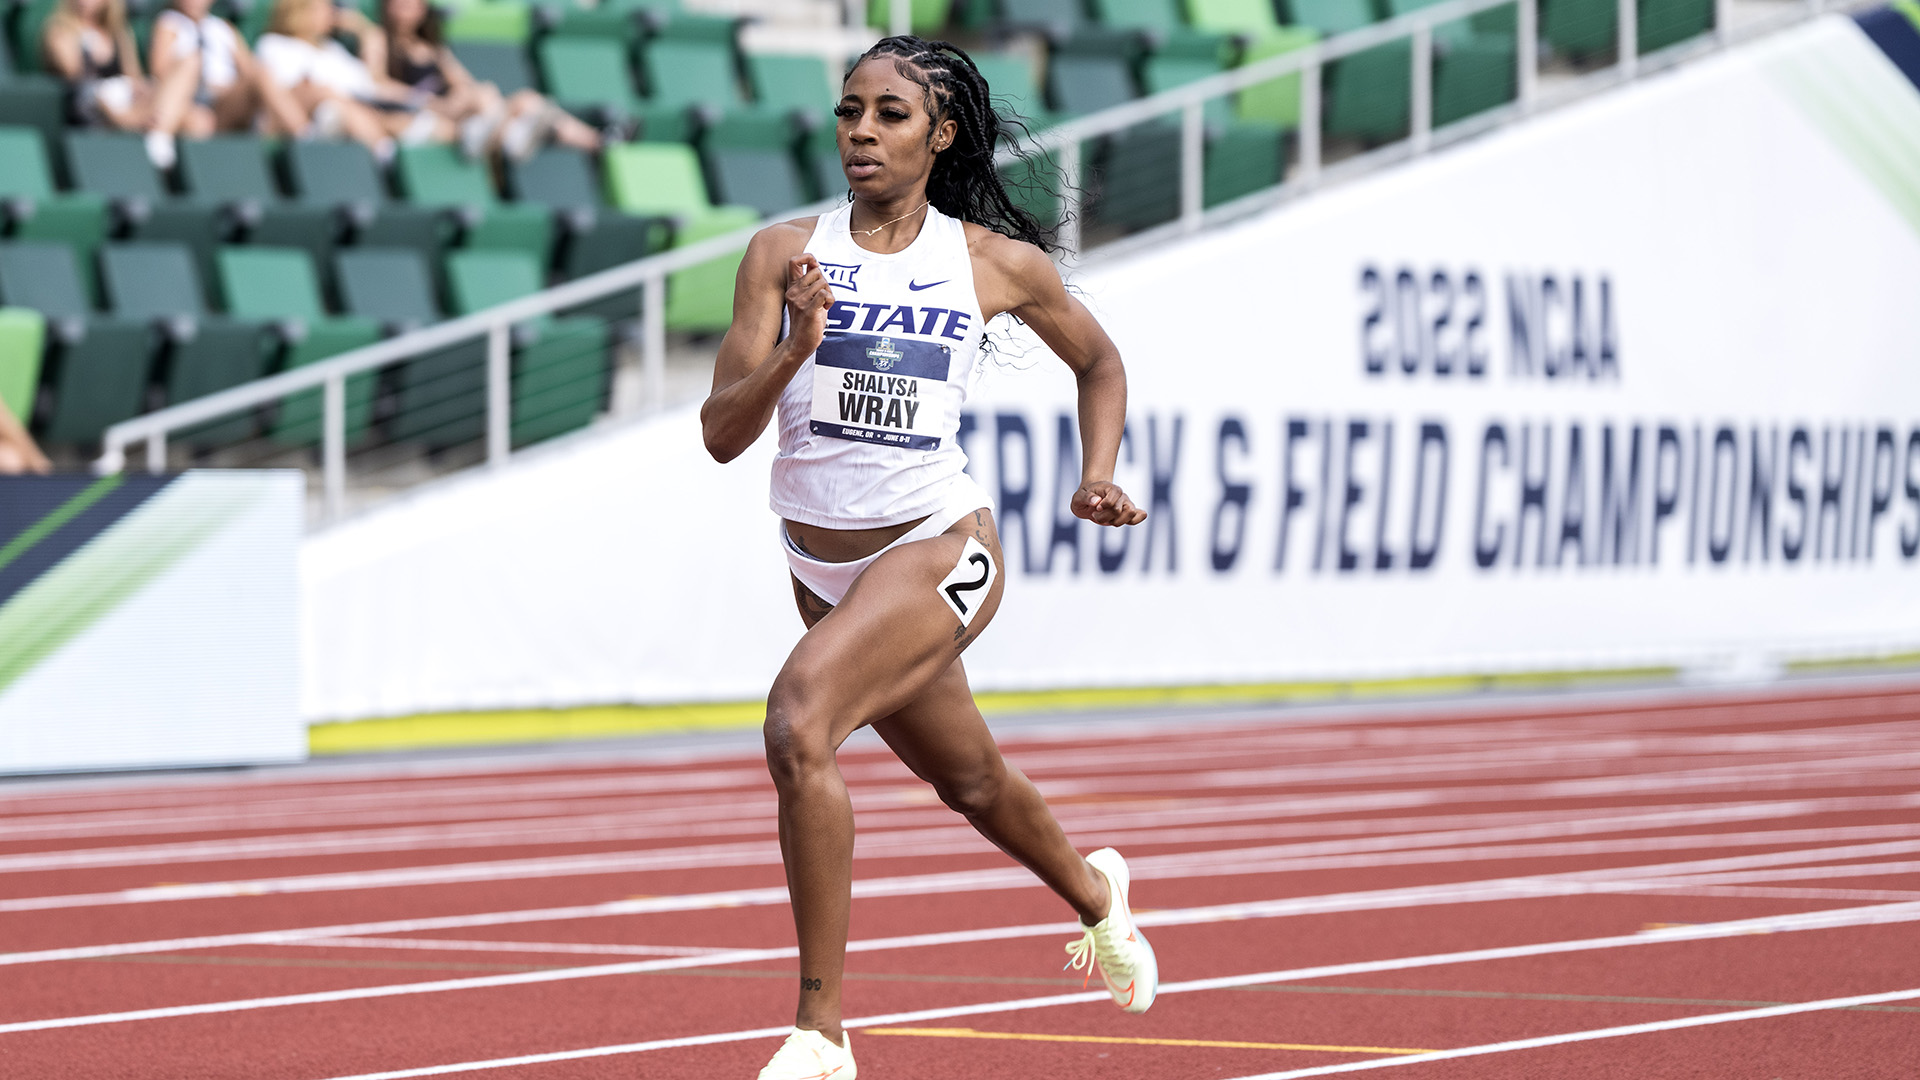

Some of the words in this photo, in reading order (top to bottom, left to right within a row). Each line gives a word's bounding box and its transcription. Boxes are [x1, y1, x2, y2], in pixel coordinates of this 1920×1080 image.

[827, 300, 971, 341] STATE
[1358, 266, 1488, 379] 2022
[1503, 273, 1620, 382] NCAA
[842, 371, 918, 398] SHALYSA
[838, 391, 920, 430] WRAY
[883, 433, 899, 442] JUNE
[1207, 415, 1255, 576] &
[1272, 416, 1451, 575] FIELD
[1471, 419, 1920, 573] CHAMPIONSHIPS
[945, 552, 989, 616] 2
